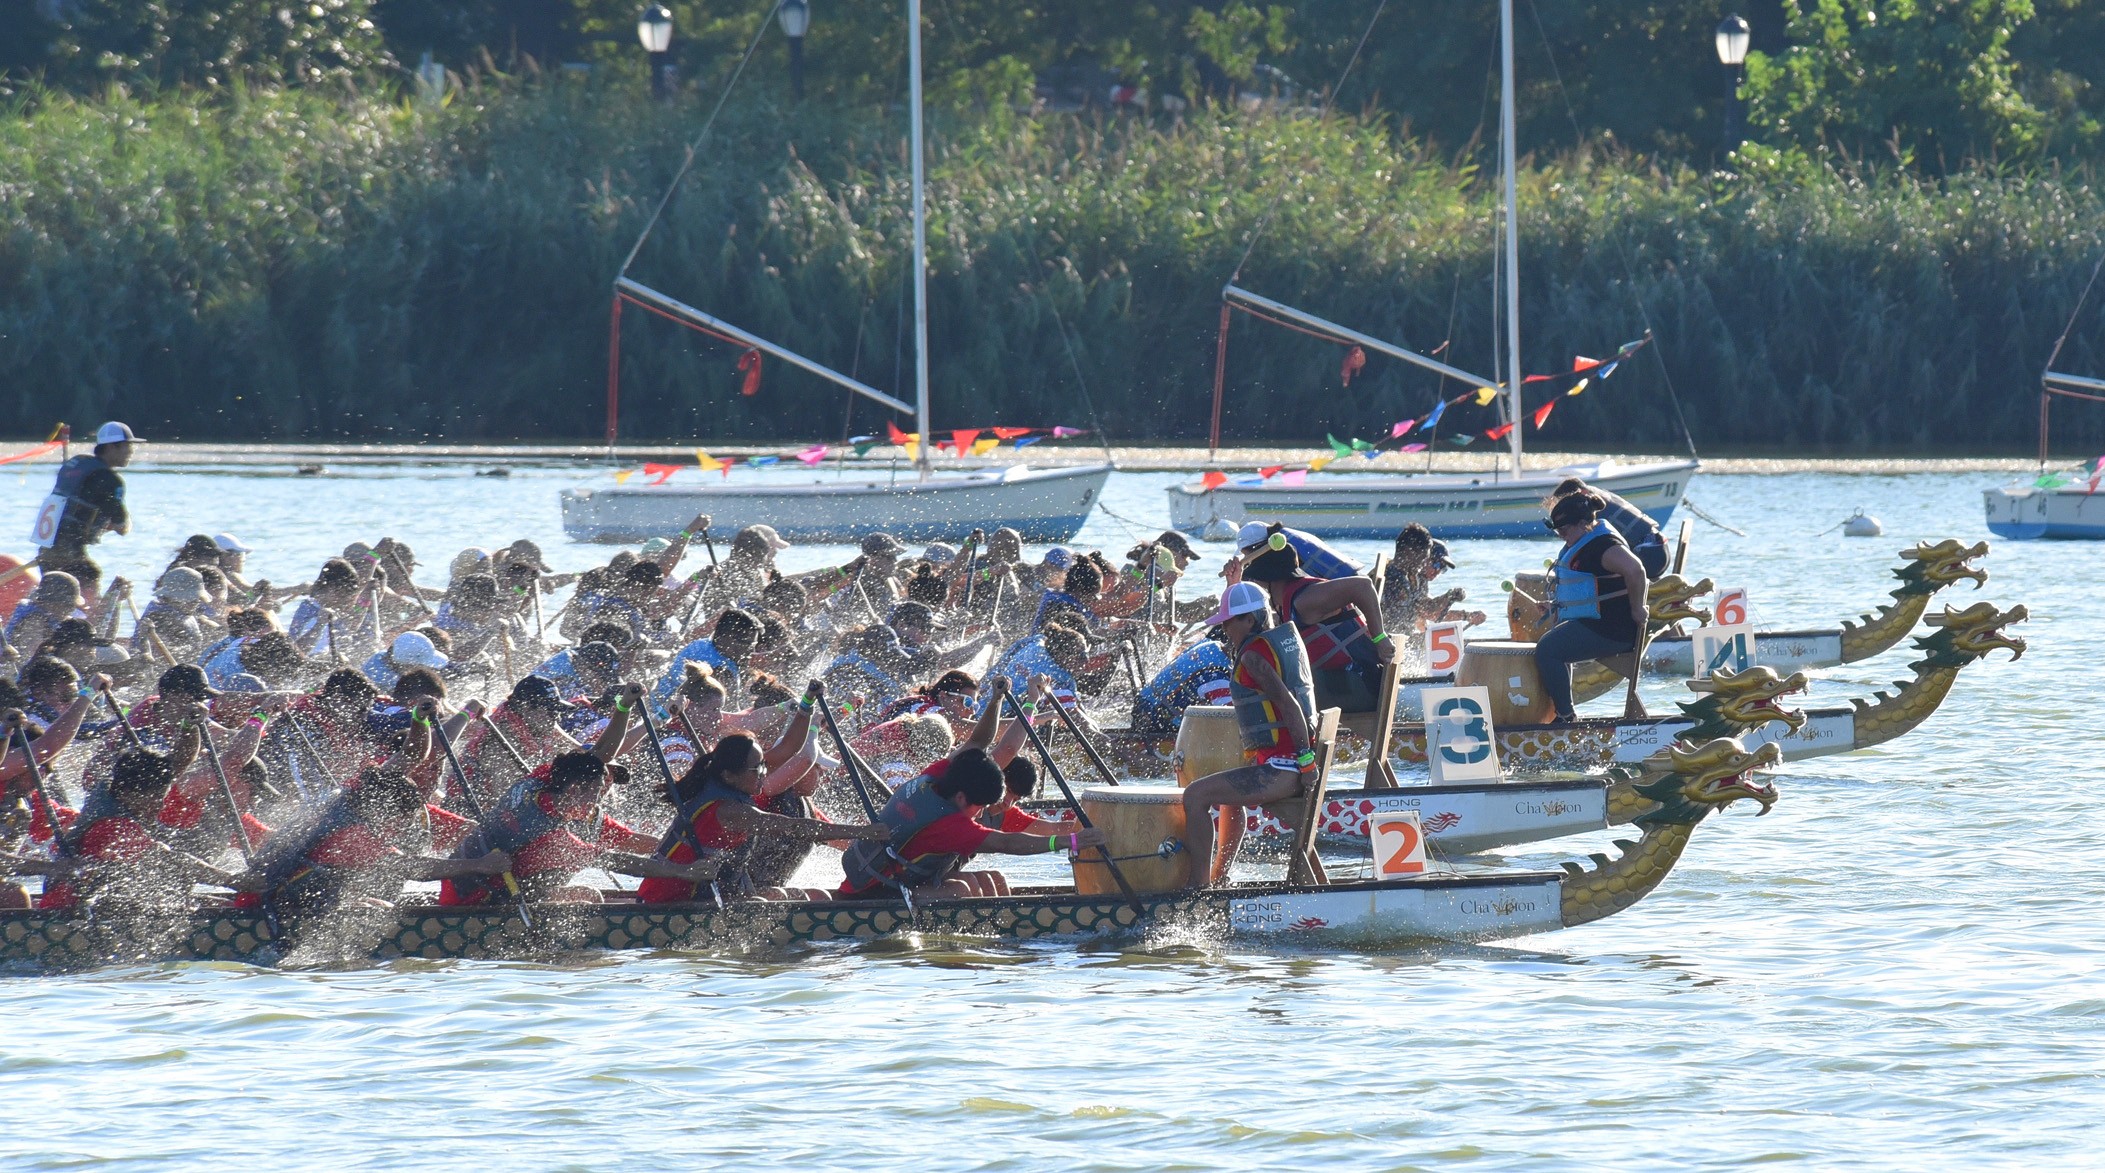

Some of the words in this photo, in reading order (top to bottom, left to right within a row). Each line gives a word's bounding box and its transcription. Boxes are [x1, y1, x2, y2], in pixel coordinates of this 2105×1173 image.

[37, 504, 57, 540] 6
[1716, 592, 1745, 626] 6
[1431, 627, 1460, 670] 5
[1620, 728, 1658, 737] HONG
[1620, 737, 1658, 746] KONG
[1378, 798, 1421, 808] HONG
[1377, 821, 1424, 874] 2
[1234, 902, 1282, 913] HONG
[1234, 913, 1282, 924] KONG
